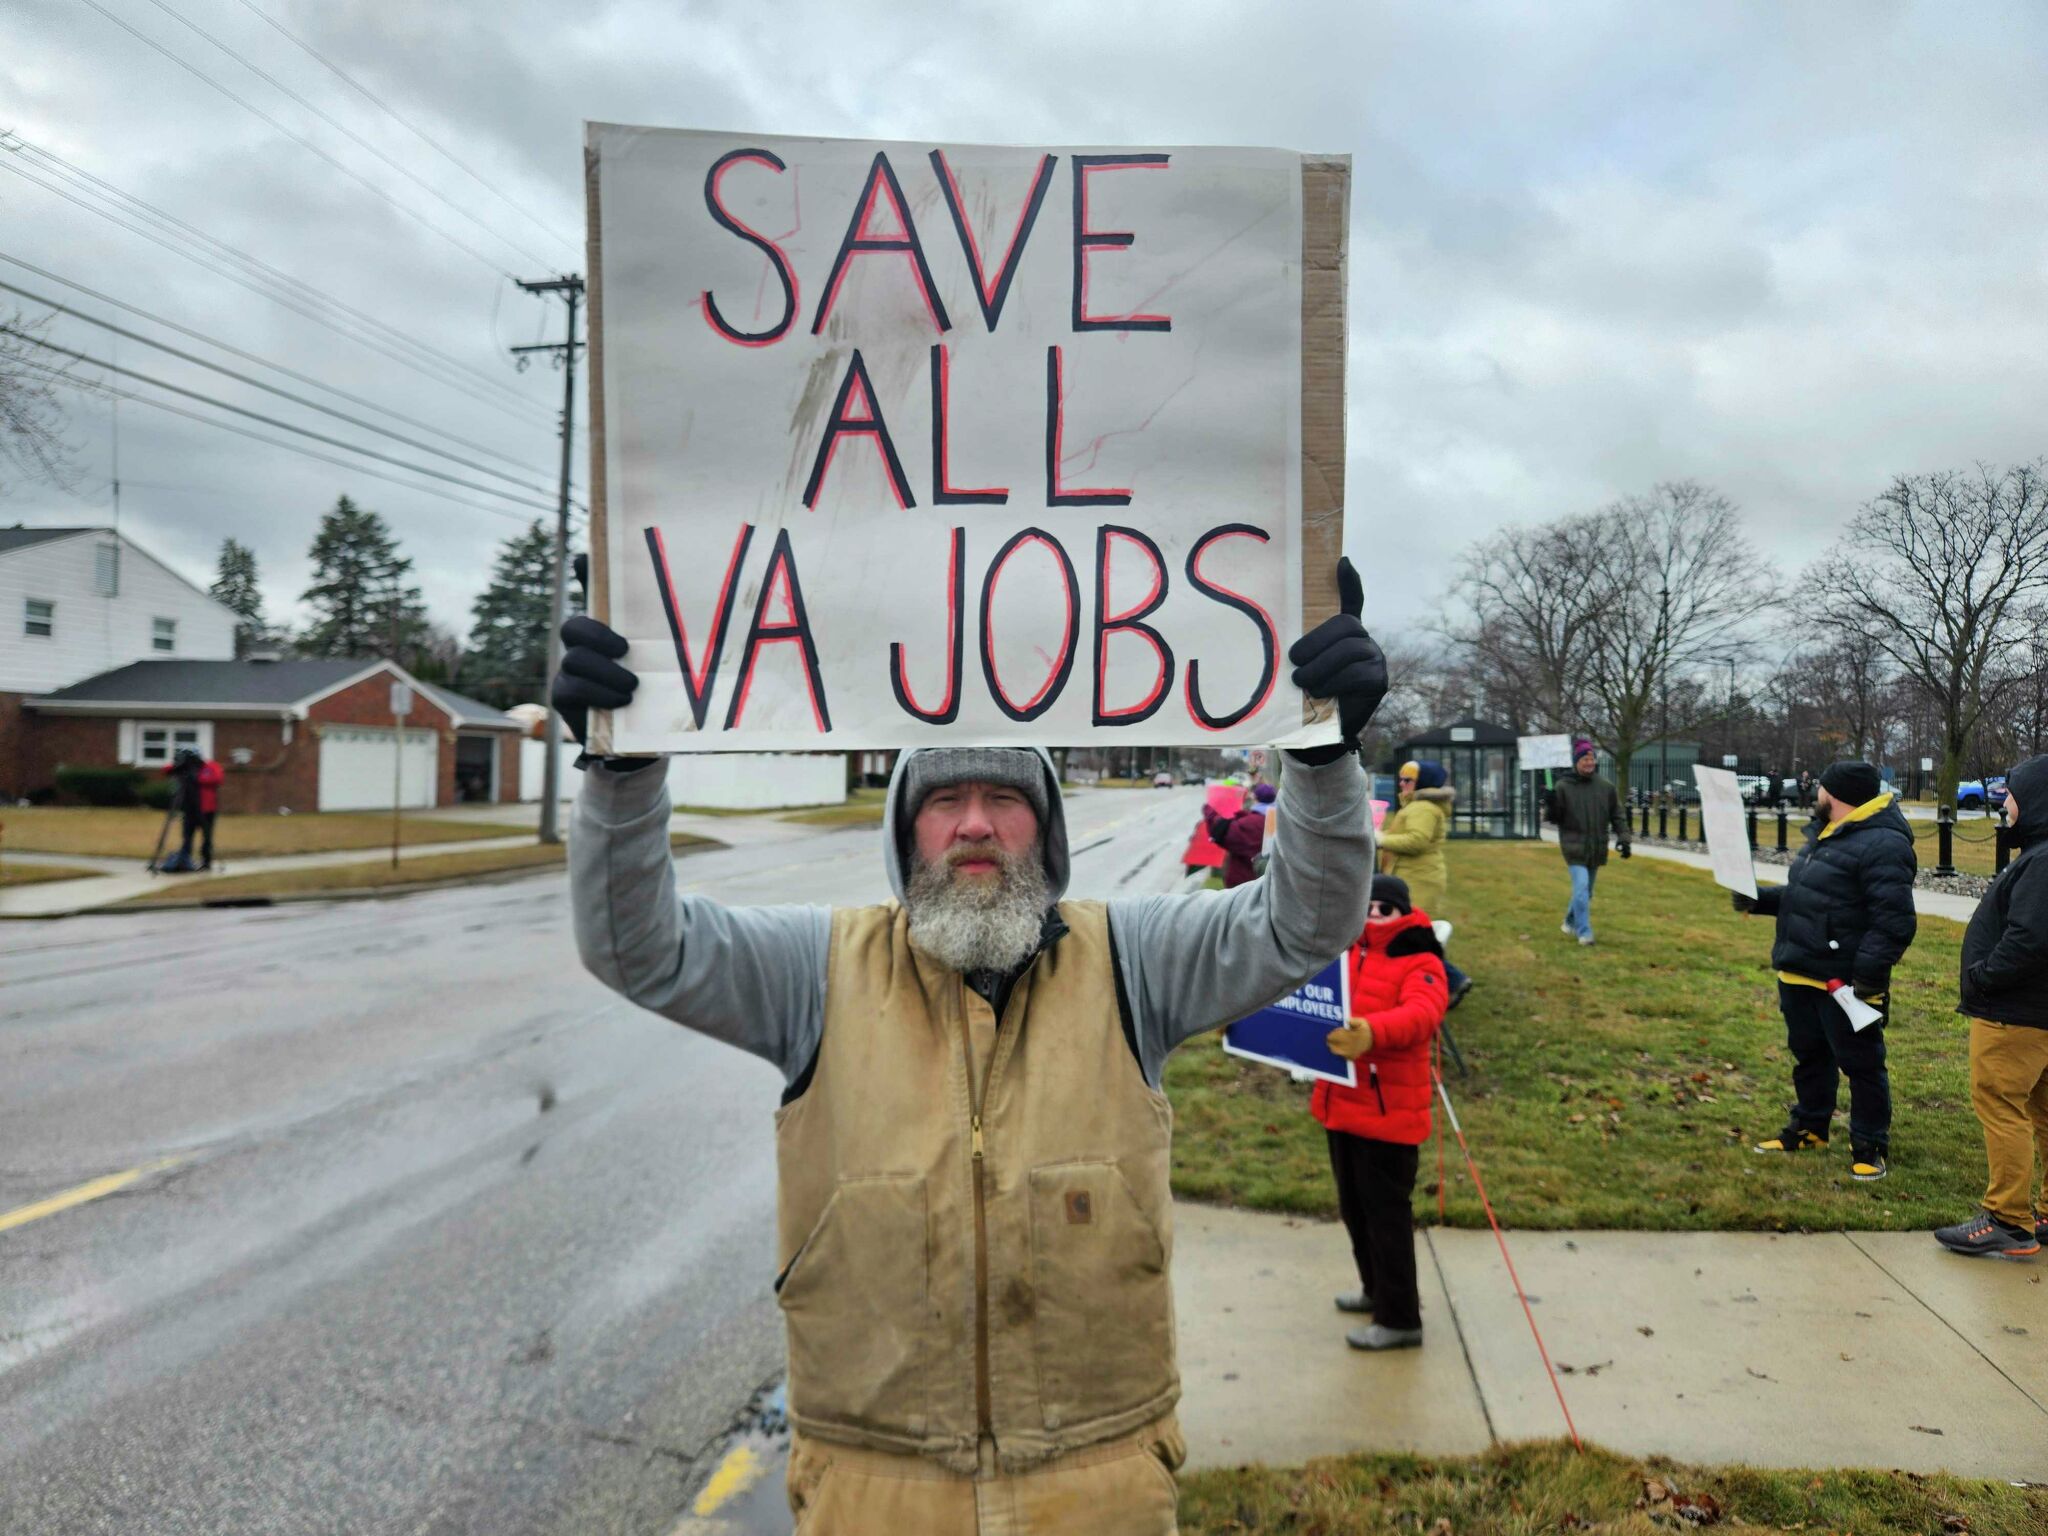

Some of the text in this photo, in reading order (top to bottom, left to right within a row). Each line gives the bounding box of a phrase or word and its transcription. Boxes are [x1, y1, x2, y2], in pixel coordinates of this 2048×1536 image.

[702, 148, 1172, 346] SAVE
[802, 344, 1132, 510] ALL
[644, 522, 1280, 733] VA JOBS
[1273, 996, 1343, 1021] MPLOYEES
[1305, 984, 1334, 1002] OUR
